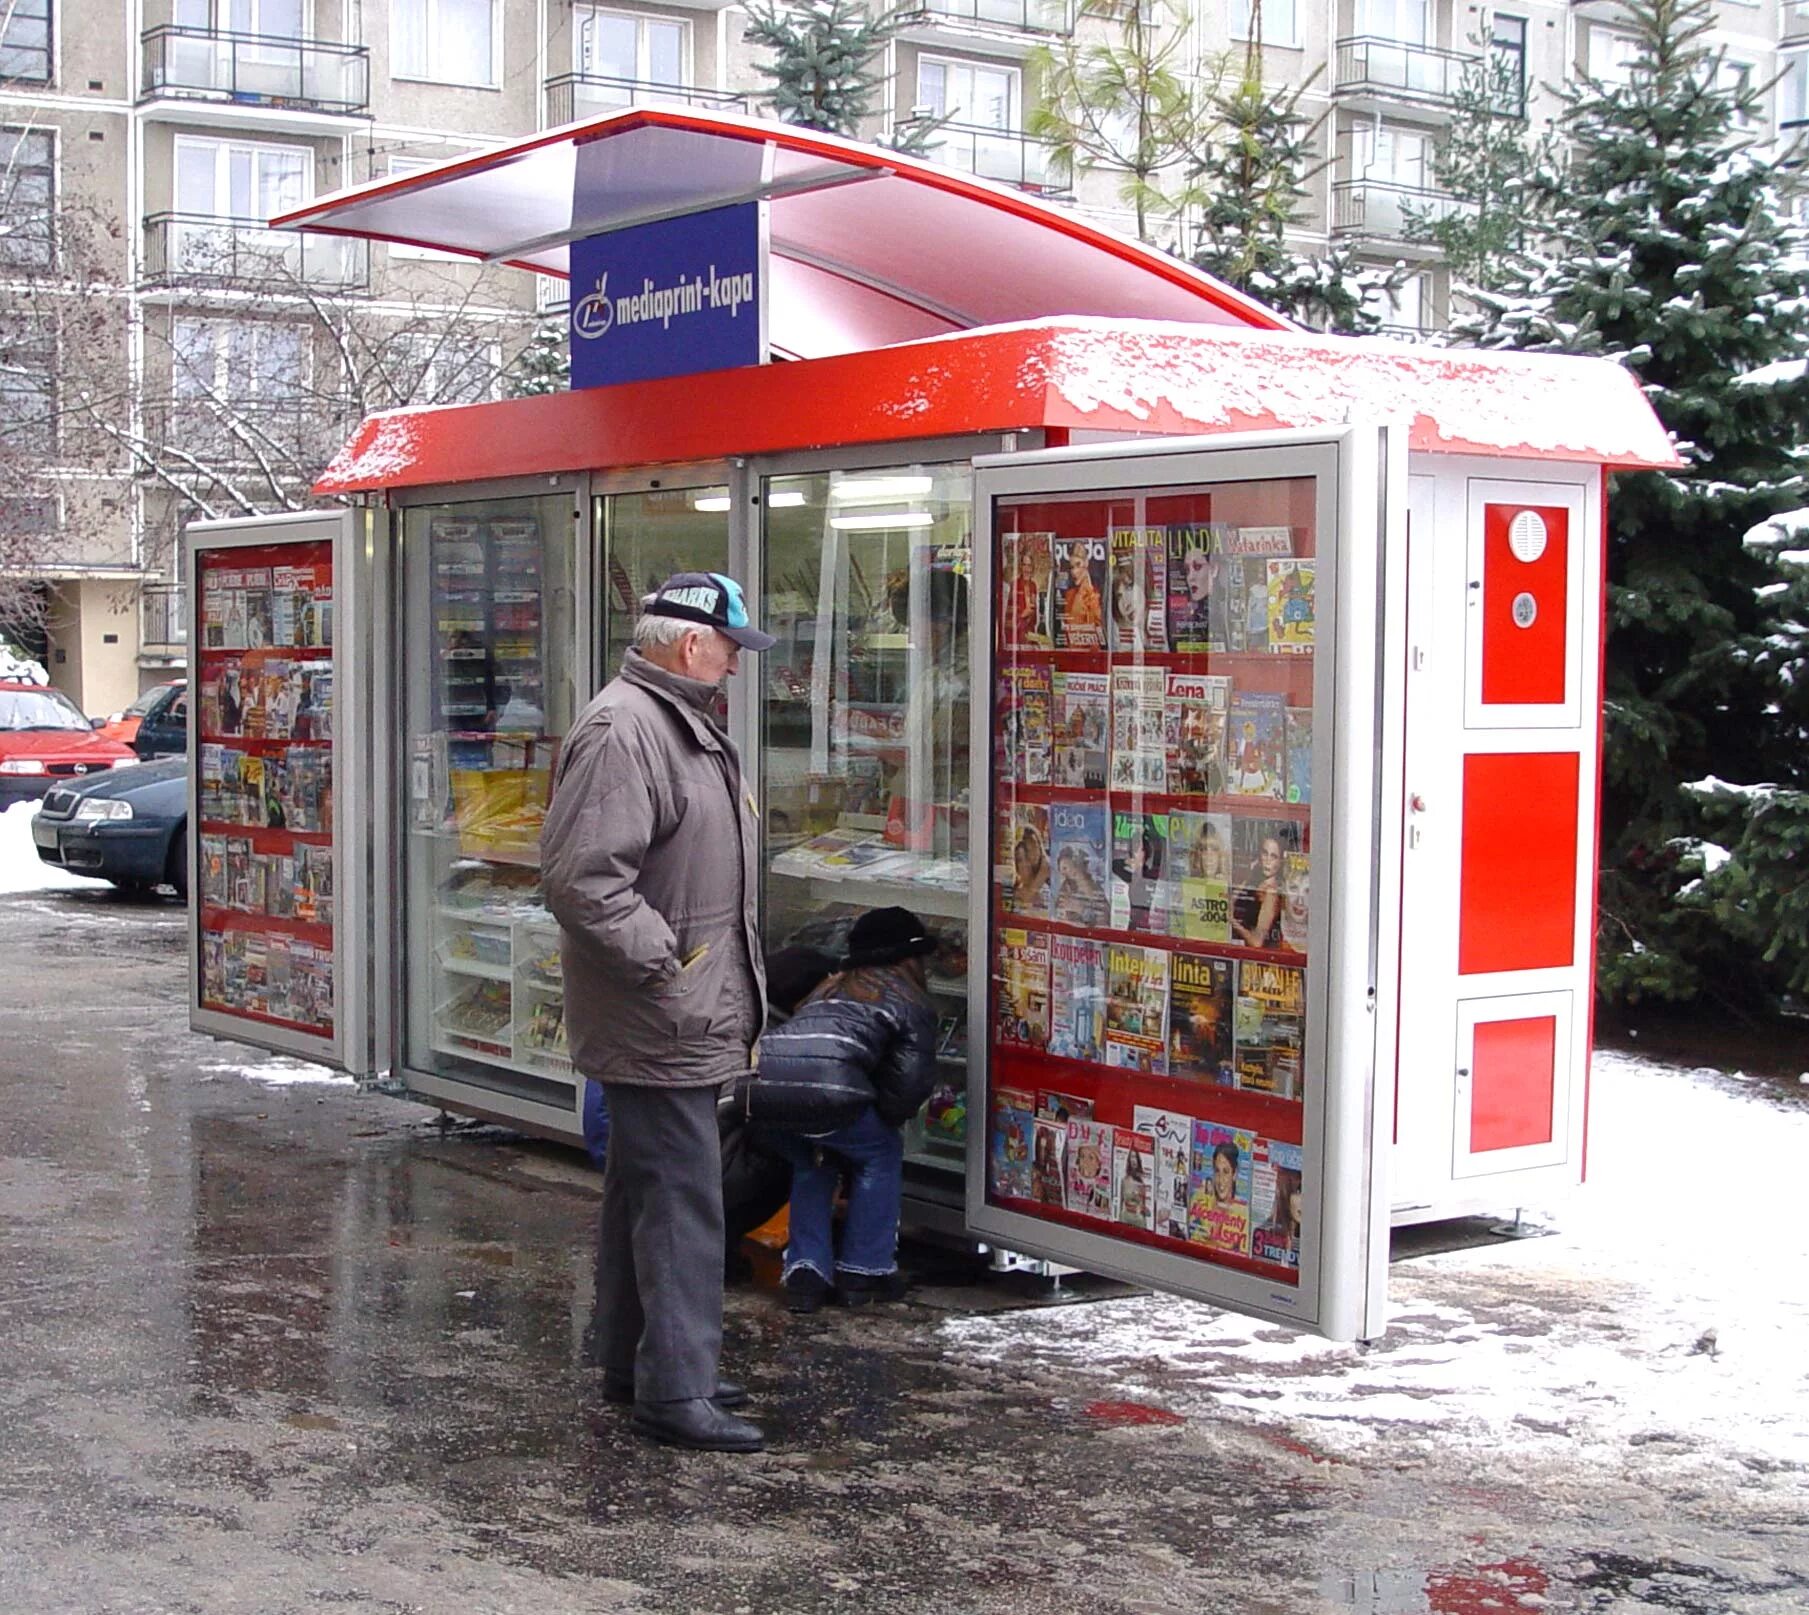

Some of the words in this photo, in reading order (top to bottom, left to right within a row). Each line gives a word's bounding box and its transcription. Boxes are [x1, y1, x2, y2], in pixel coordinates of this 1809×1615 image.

[616, 265, 753, 330] mediaprint-kapa
[1168, 528, 1223, 559] LINDA
[1166, 676, 1205, 699] Lena
[1191, 897, 1228, 912] ASTRO
[1200, 910, 1228, 924] 2004
